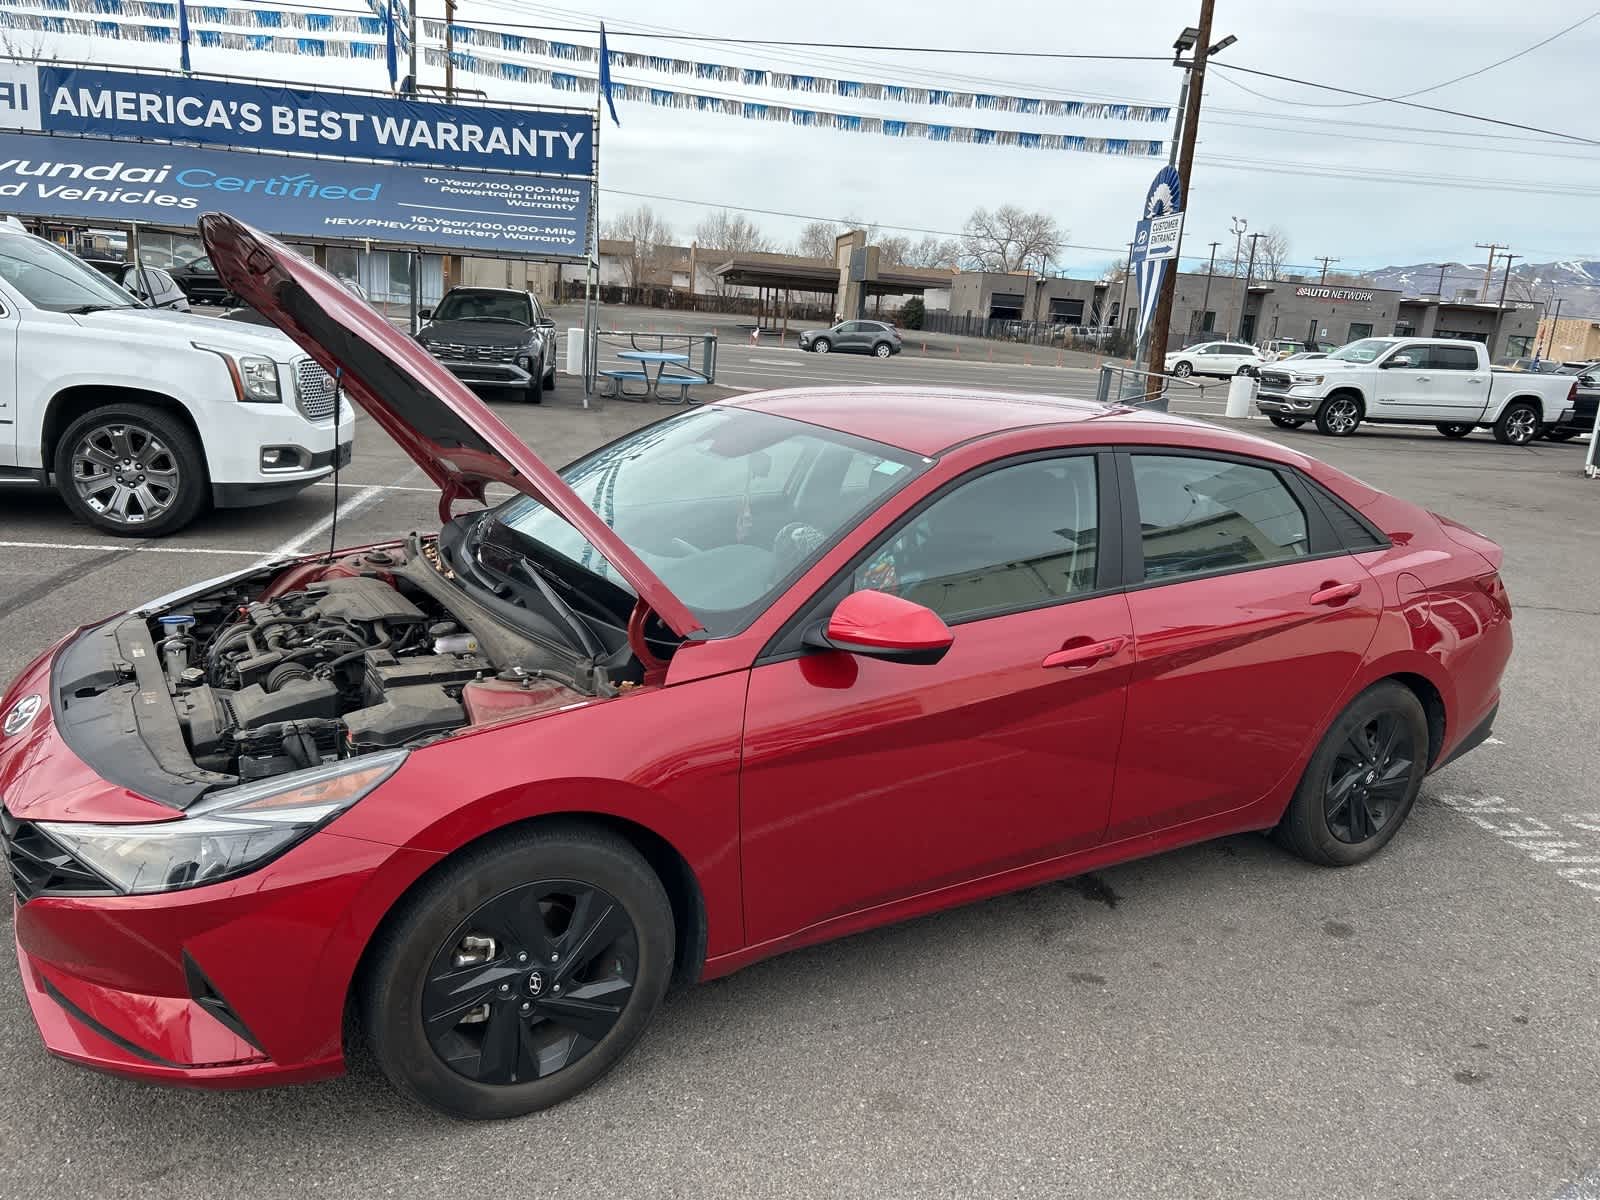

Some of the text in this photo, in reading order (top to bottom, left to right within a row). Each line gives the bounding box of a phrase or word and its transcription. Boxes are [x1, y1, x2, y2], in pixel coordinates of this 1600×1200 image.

[51, 87, 584, 159] AMERICA'S BEST WARRANTY
[175, 168, 382, 201] Certified
[423, 176, 580, 196] 10-Year/100,000-Mile
[441, 185, 579, 203] Powertrain Limited
[37, 185, 199, 209] Vehicles
[506, 199, 576, 212] Warranty
[325, 217, 576, 245] HEV/PHEV/EV Battery Warranty
[410, 215, 576, 236] 10-Year/100,000-Mile
[1152, 218, 1179, 232] CUSTOMER
[1150, 231, 1177, 244] ENTRANCE
[1303, 287, 1374, 302] AUTO NETWORK
